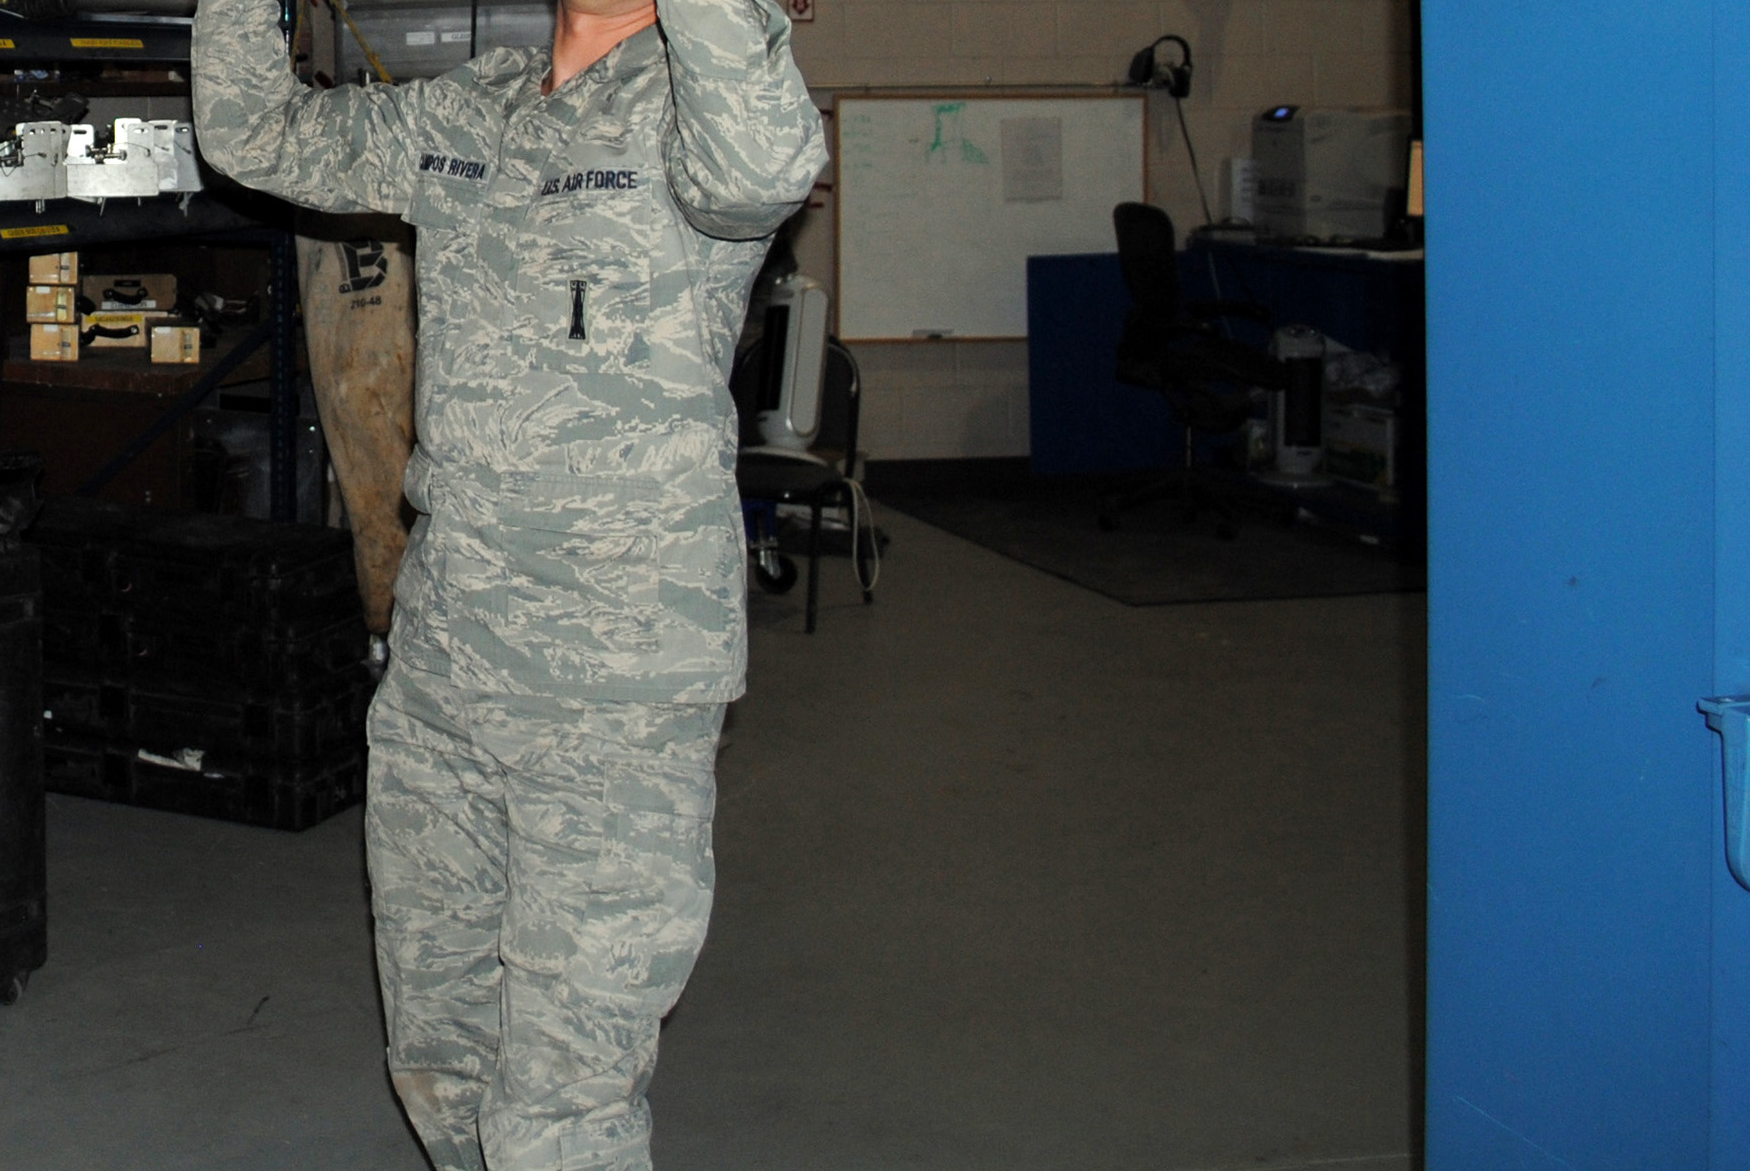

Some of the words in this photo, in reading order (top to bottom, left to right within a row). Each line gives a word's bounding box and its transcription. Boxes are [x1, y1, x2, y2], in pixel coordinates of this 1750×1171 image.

[447, 158, 486, 179] RIVERA
[562, 172, 582, 193] AIR
[585, 170, 638, 190] FORCE
